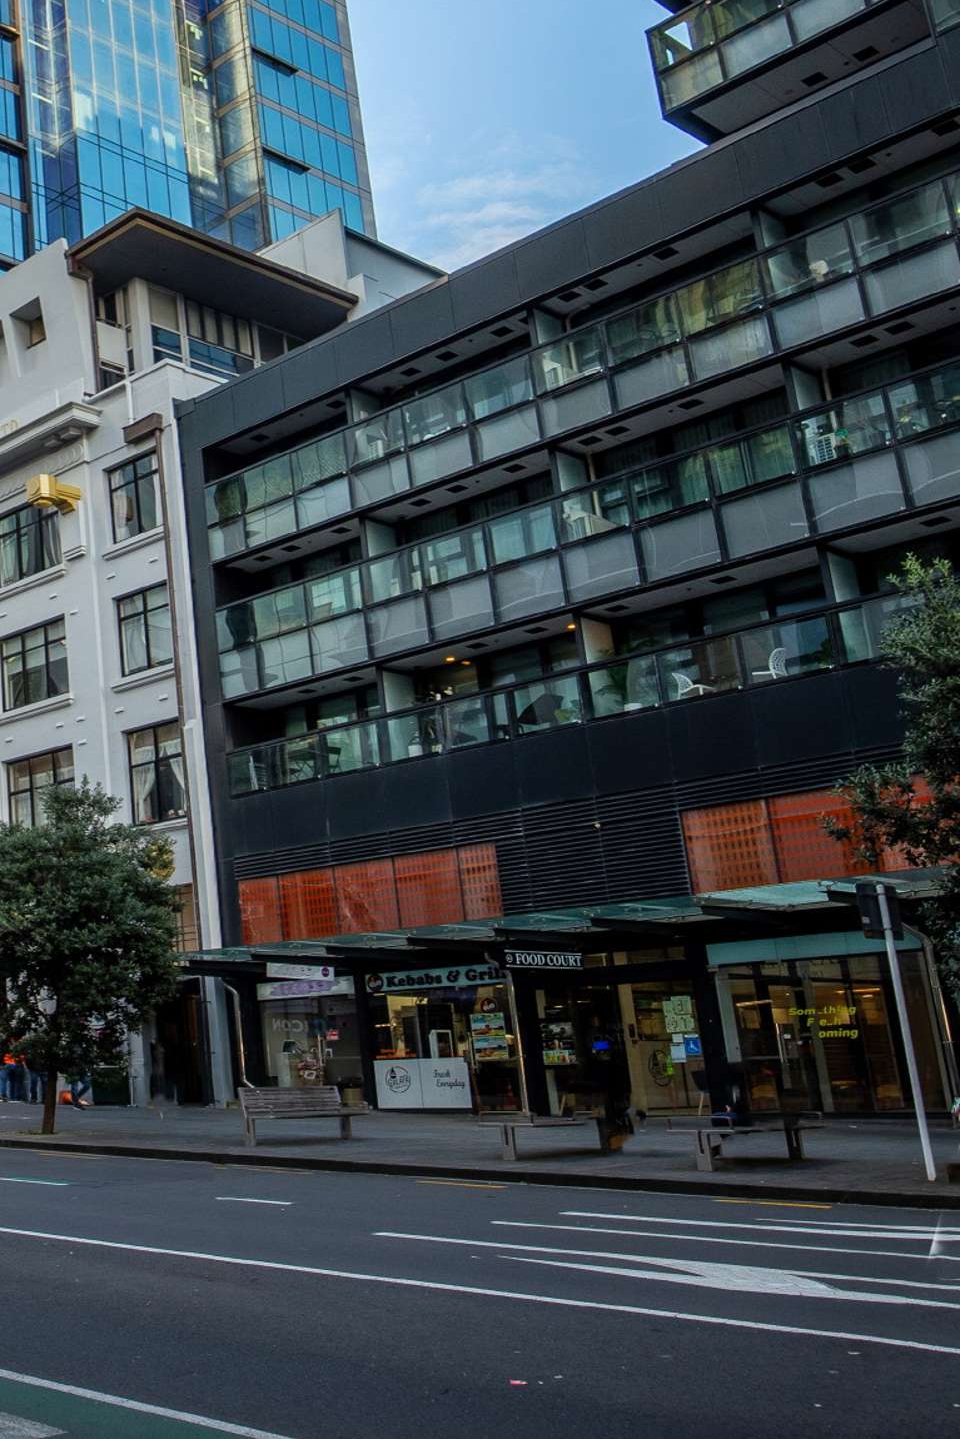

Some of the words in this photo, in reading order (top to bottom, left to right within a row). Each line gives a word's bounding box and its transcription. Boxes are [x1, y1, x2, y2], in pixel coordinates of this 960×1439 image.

[515, 953, 545, 966] FOOD
[546, 954, 582, 967] COURT
[385, 973, 442, 988] Kebabs
[446, 969, 461, 982] &
[788, 1005, 857, 1016] Somthing
[818, 1027, 859, 1040] oming
